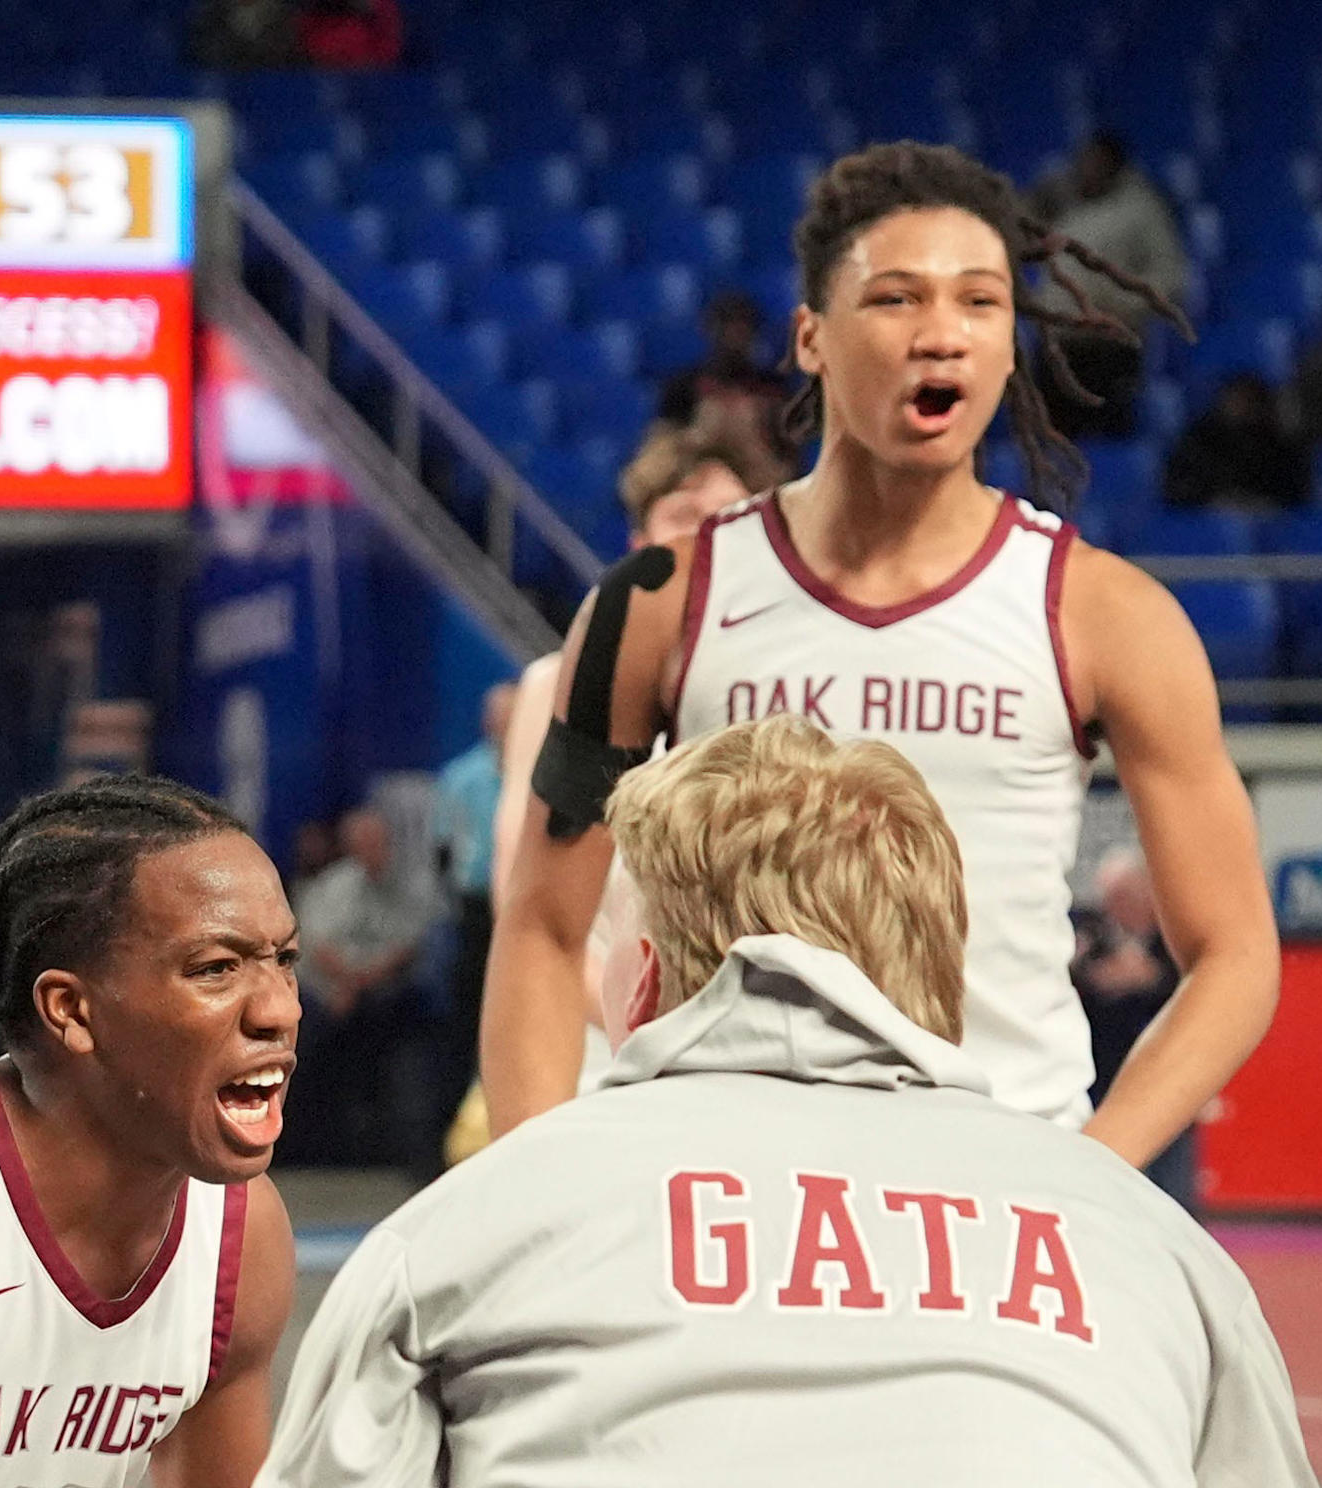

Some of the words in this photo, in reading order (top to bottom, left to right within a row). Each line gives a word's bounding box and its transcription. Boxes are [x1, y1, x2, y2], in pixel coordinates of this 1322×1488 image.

[726, 675, 837, 730] OAK
[860, 675, 1025, 742] RIDGE
[662, 1165, 1098, 1349] GATA
